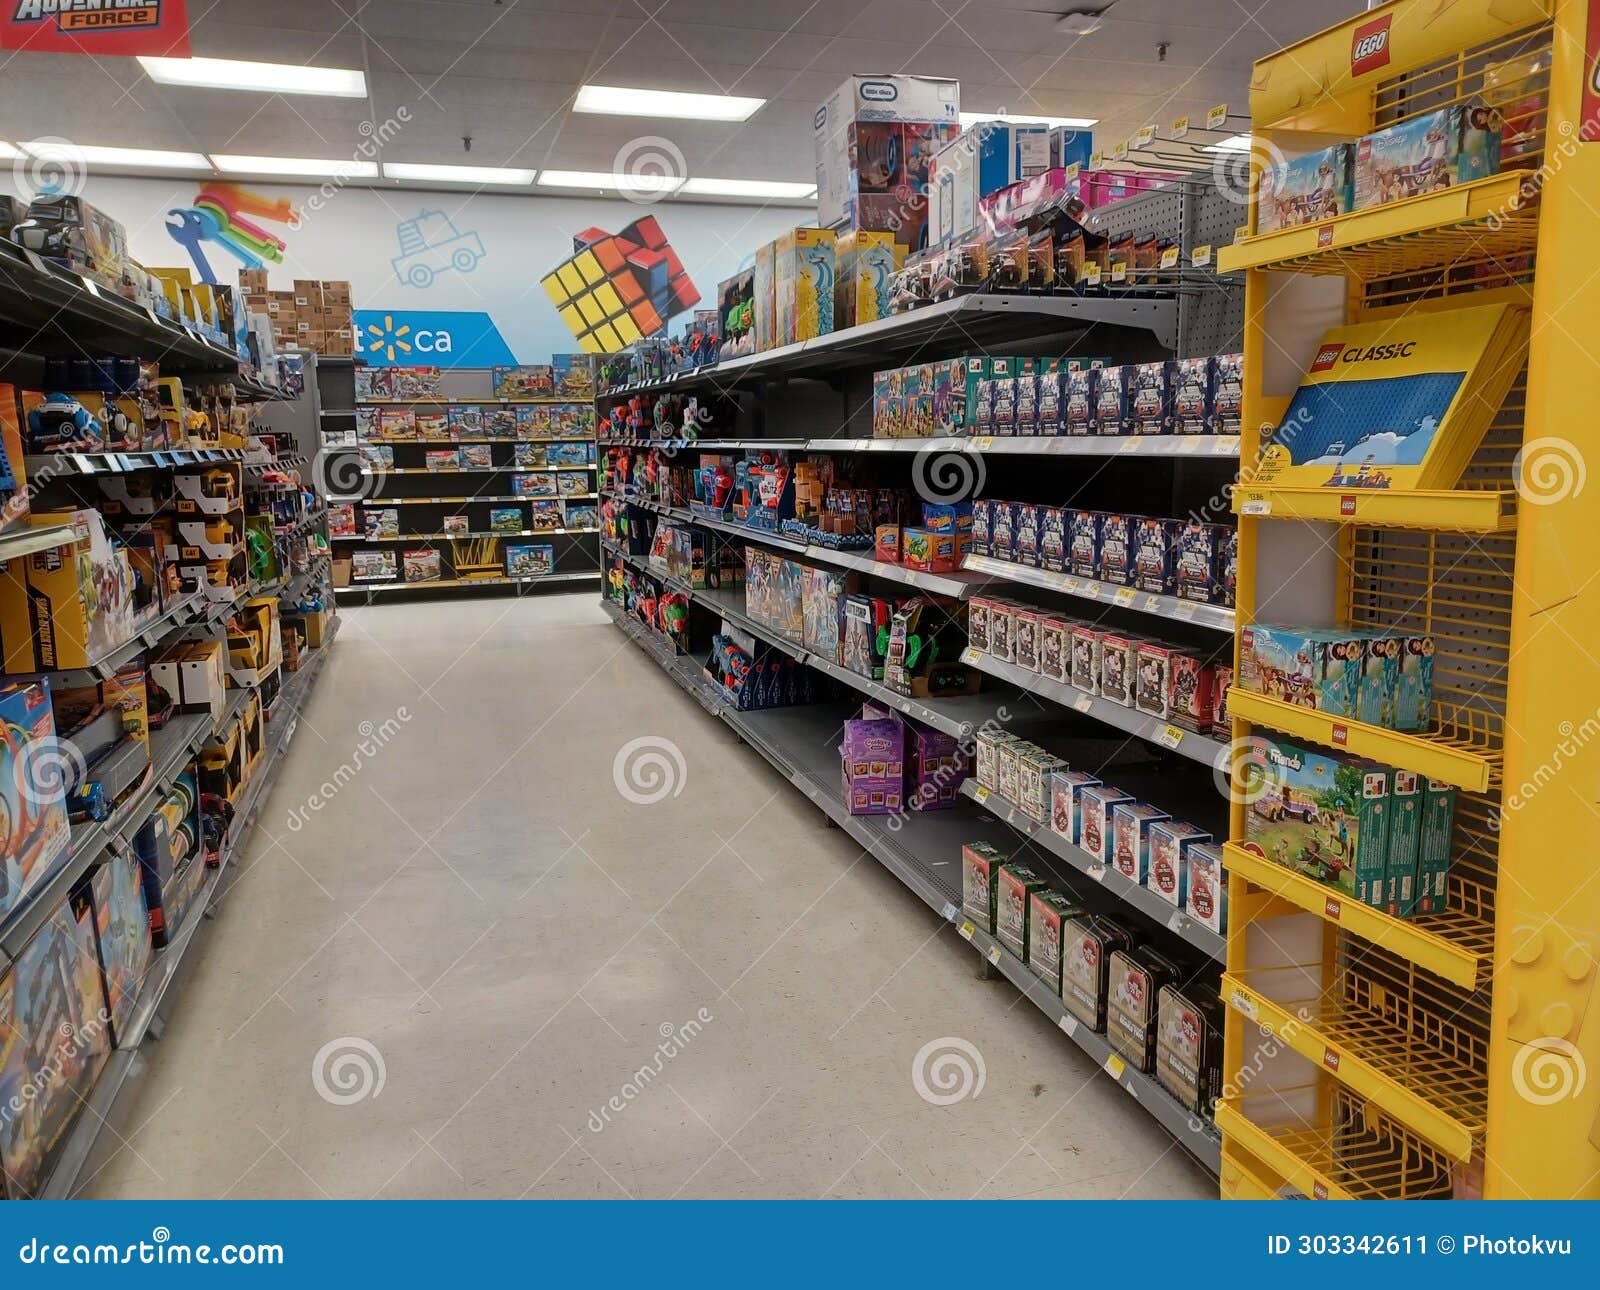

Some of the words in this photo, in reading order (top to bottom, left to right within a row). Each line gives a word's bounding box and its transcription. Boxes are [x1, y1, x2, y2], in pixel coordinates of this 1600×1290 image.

[70, 10, 148, 26] FORCE
[1354, 30, 1388, 61] LEGO
[415, 331, 452, 352] ca
[1315, 350, 1338, 364] LEGO
[180, 502, 192, 511] CAT
[185, 549, 197, 557] CAT
[1270, 748, 1303, 771] Friends
